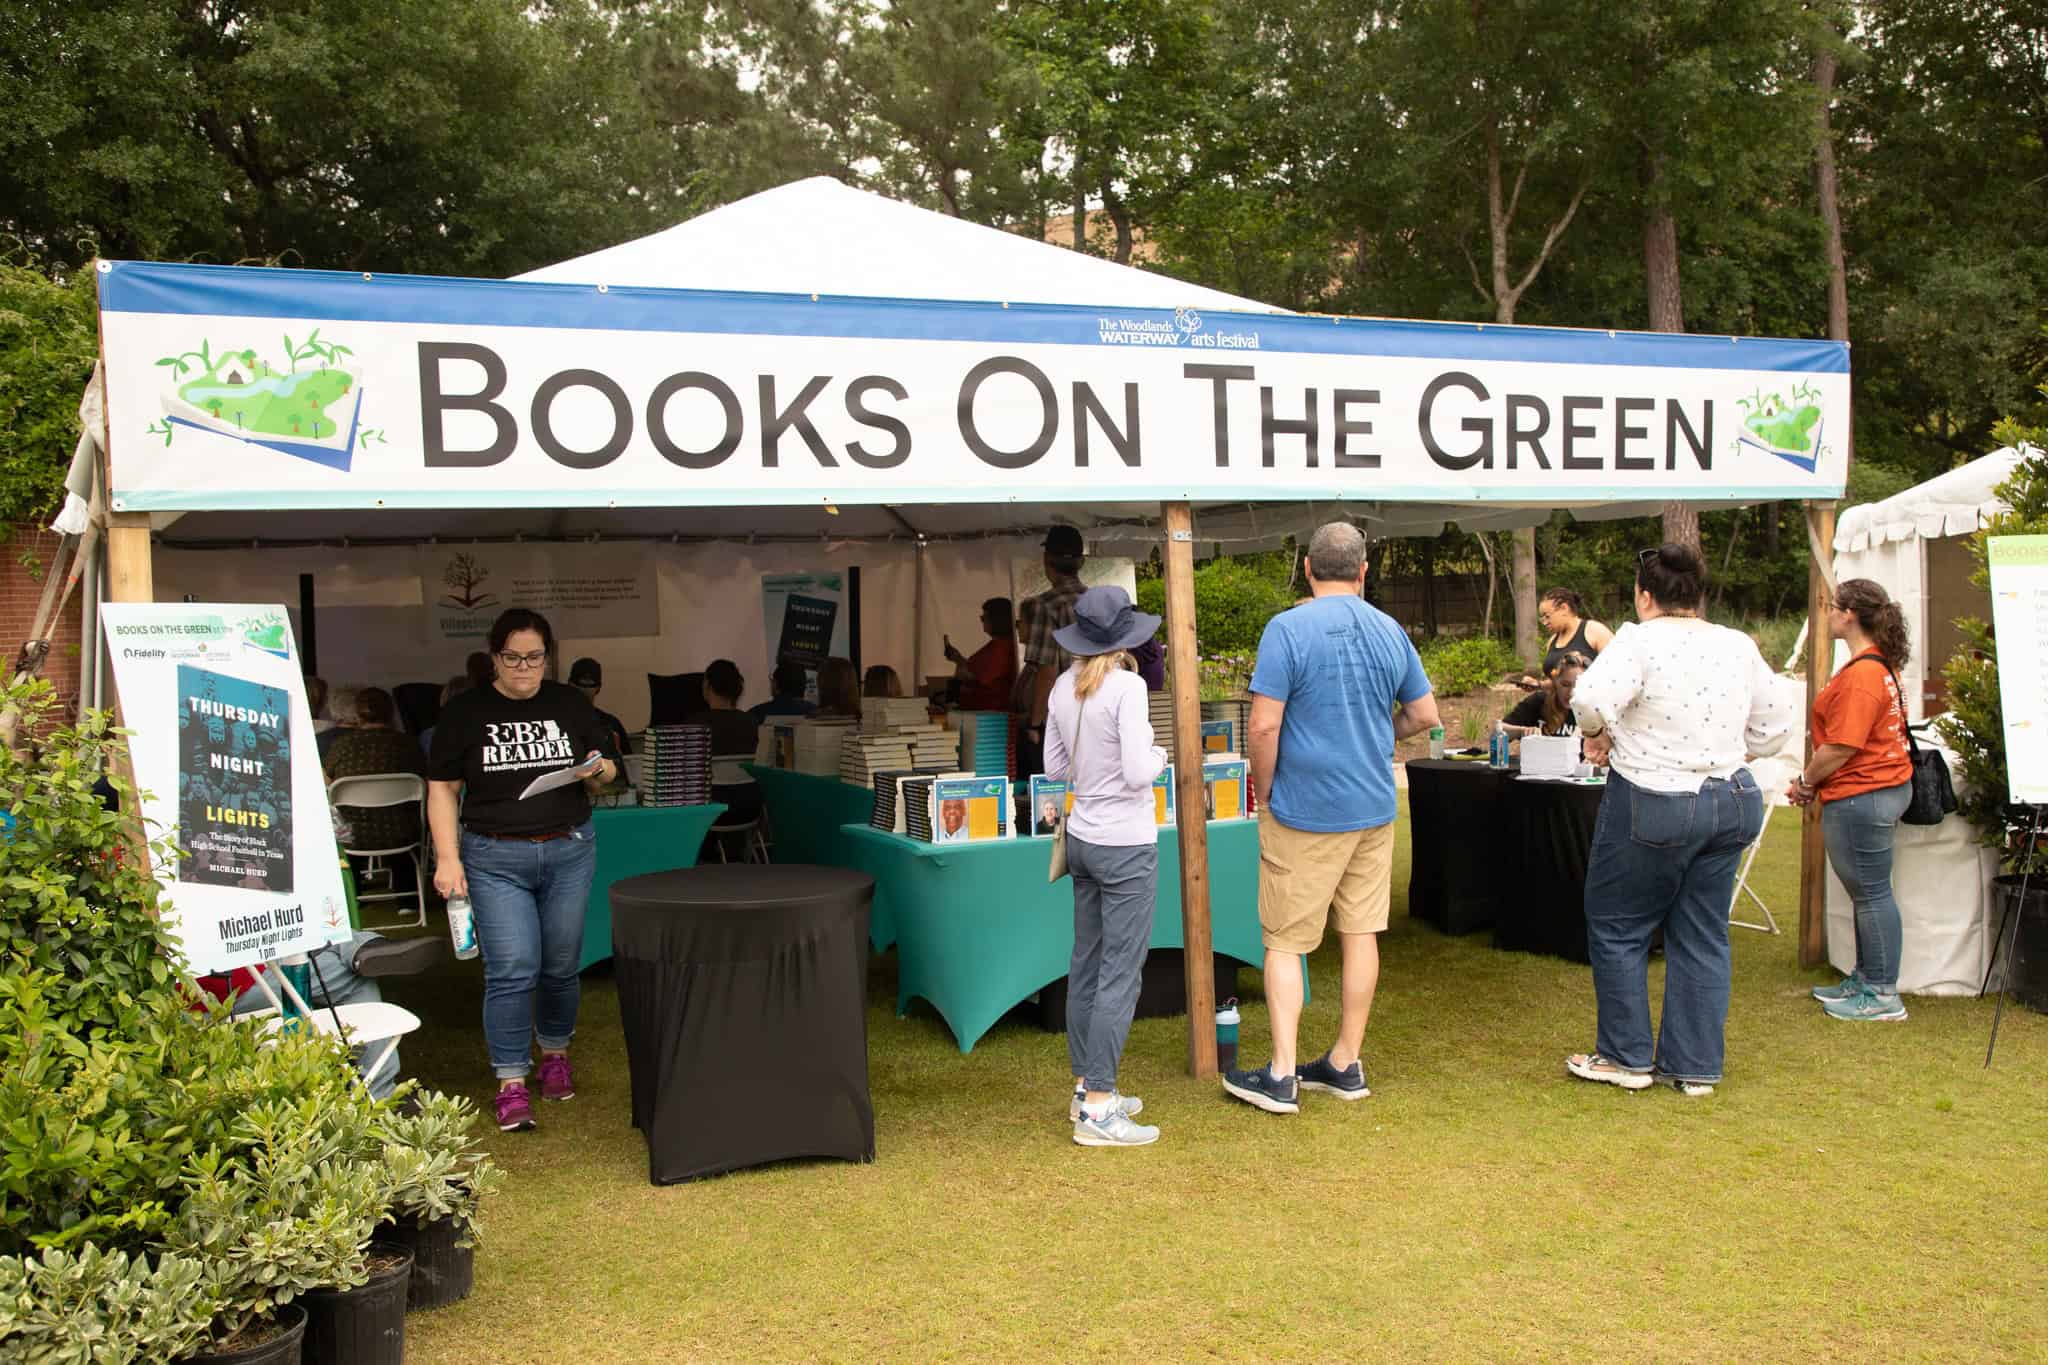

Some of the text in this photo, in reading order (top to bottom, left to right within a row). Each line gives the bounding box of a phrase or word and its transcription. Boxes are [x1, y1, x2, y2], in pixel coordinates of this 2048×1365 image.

[1098, 318, 1174, 332] The Woodlands
[1099, 331, 1260, 349] WATERWAY arts festival
[418, 341, 1713, 472] BOOKS ON THE GREEN
[116, 625, 148, 635] BOOKS
[150, 625, 164, 634] ON
[164, 625, 183, 634] THE
[183, 625, 211, 634] GREEN
[134, 649, 166, 658] Fidelity
[190, 696, 279, 729] THURSDAY
[485, 720, 569, 746] REBEL
[482, 741, 574, 764] READER
[211, 753, 264, 776] NIGHT
[206, 805, 270, 829] LIGHTS
[209, 864, 245, 875] MICHAEL
[219, 904, 304, 940] Michael Hurd
[226, 927, 303, 954] Thursday Night Lights
[264, 947, 276, 960] pm
